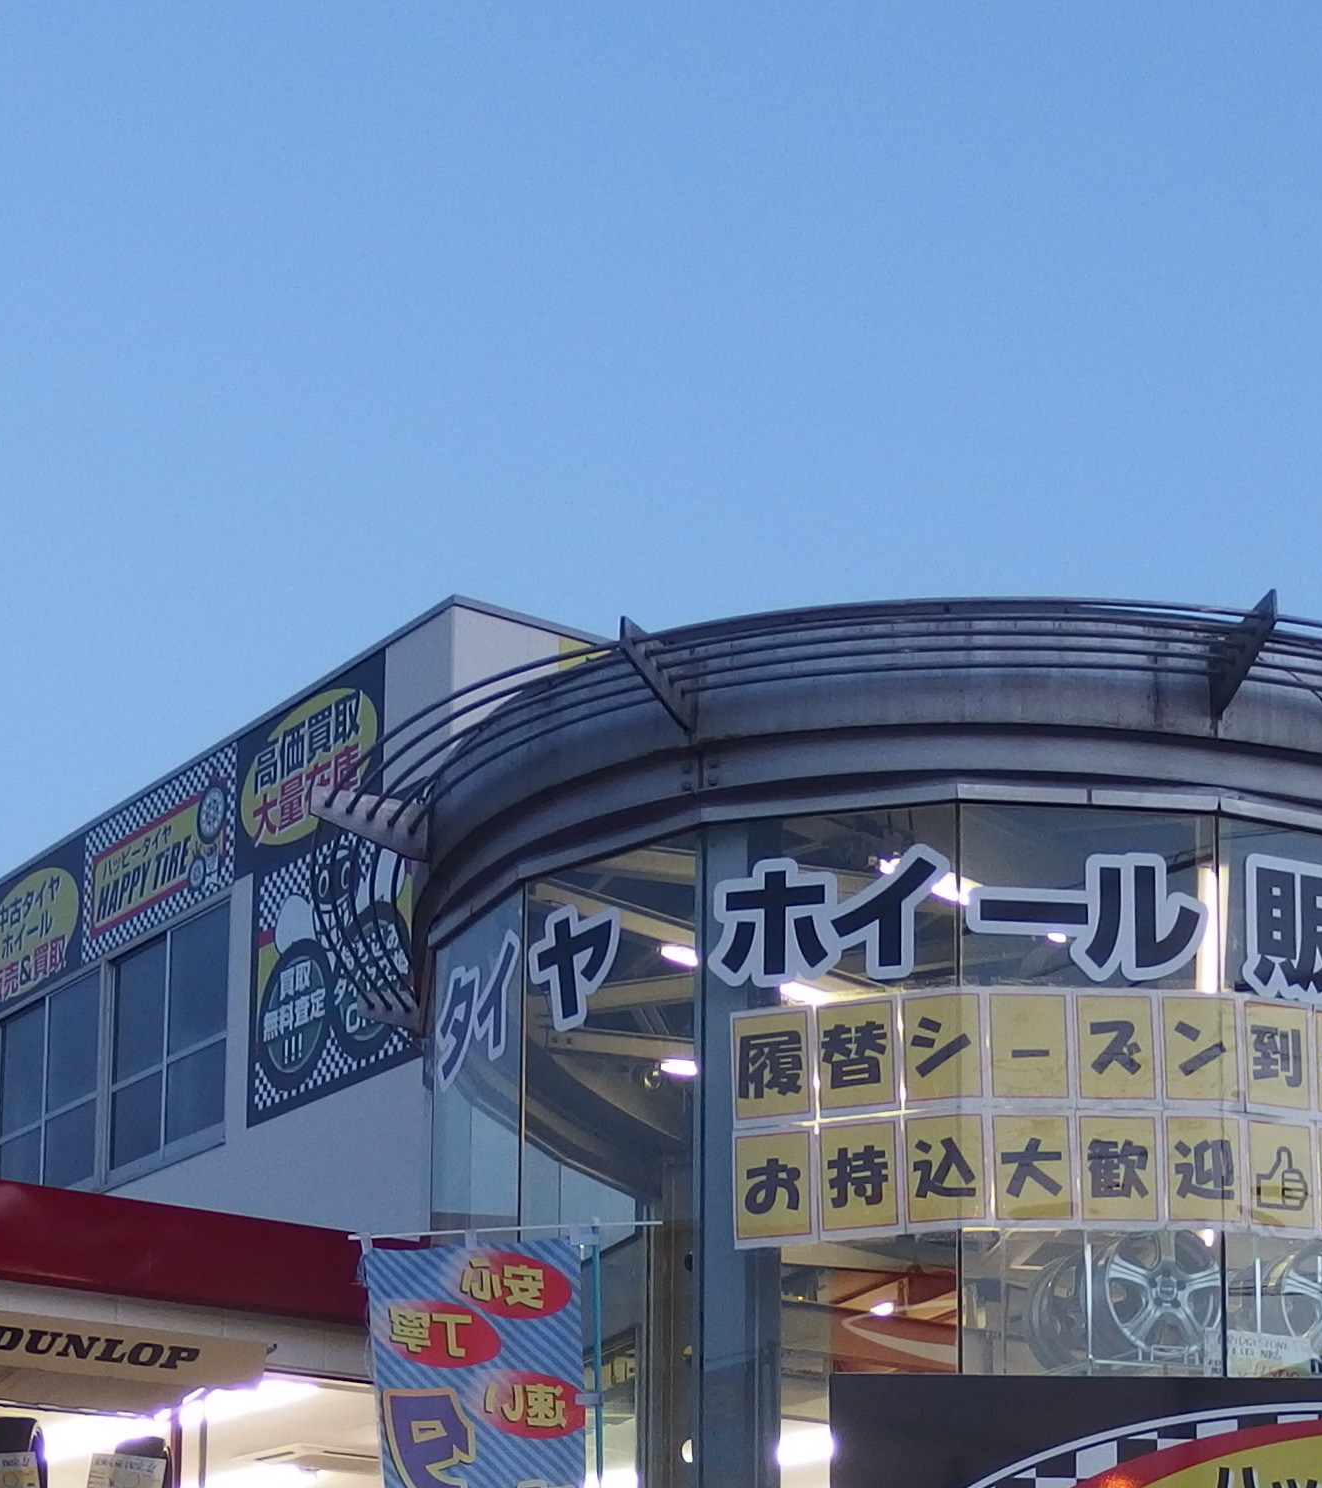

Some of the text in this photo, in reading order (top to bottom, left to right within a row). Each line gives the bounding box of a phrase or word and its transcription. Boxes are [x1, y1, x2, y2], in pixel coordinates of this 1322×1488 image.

[255, 690, 362, 796] 高価買取
[102, 825, 172, 879] ハッピータイヤ
[97, 862, 152, 924] HAPPY
[1, 910, 53, 959] ホイール
[279, 960, 312, 1000] 買取
[438, 903, 621, 1090] タイヤ
[708, 843, 1210, 987] ホイール
[263, 986, 326, 1042] 無料査定
